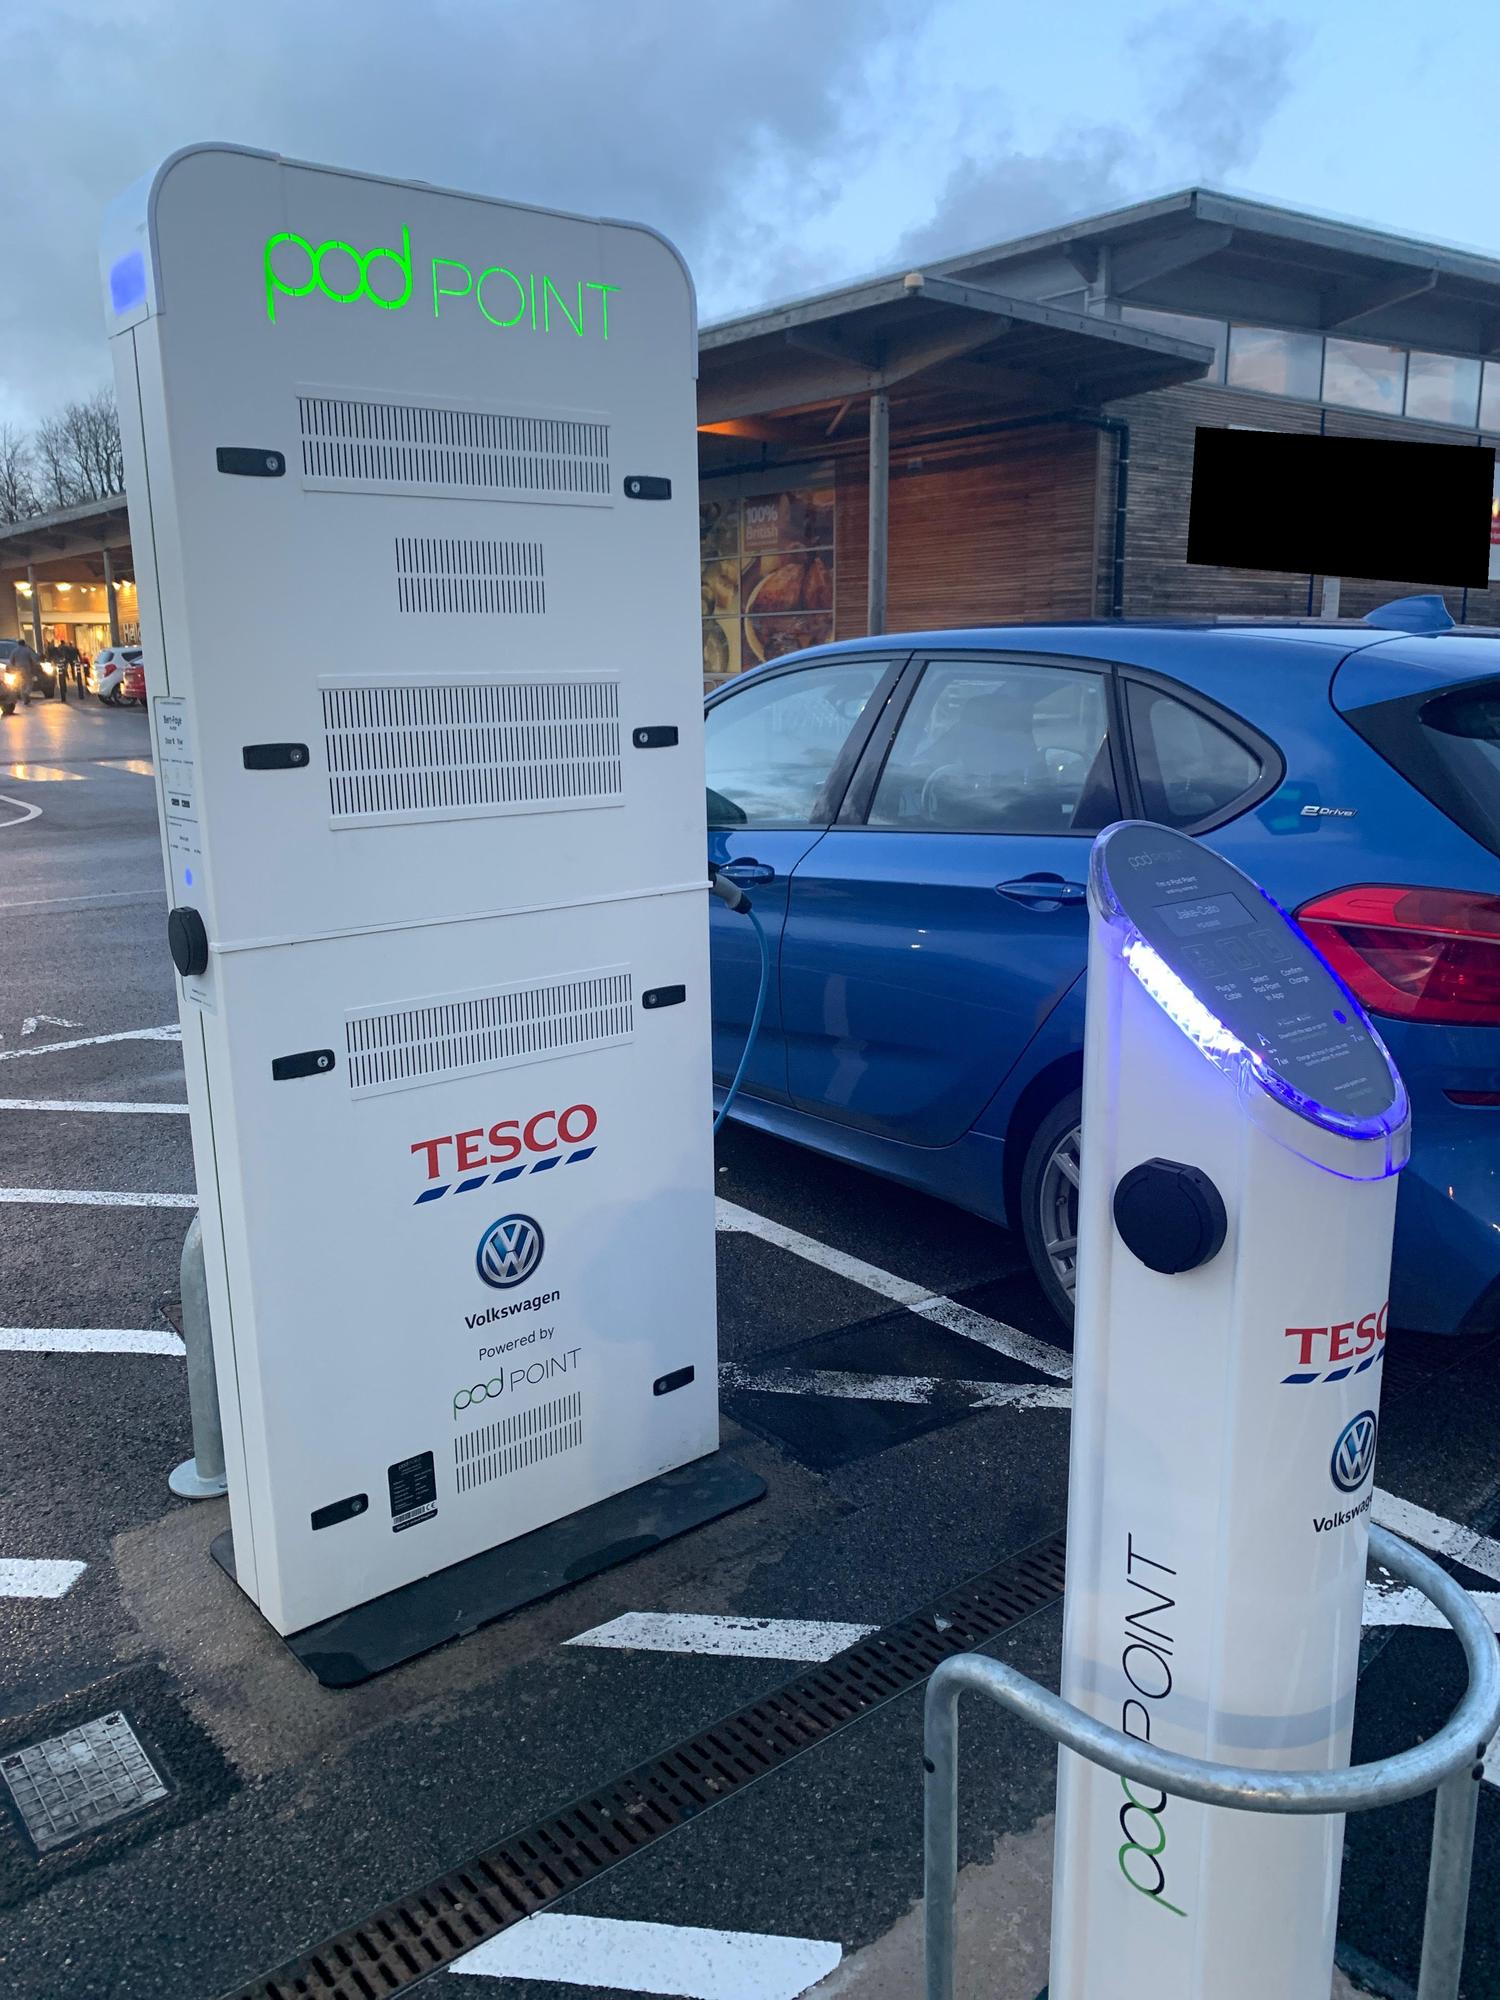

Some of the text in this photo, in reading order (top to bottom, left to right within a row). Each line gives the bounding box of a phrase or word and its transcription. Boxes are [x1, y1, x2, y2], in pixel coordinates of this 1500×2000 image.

[263, 224, 621, 340] pod POINT
[1256, 1032, 1272, 1047] A
[411, 1104, 598, 1180] TESCO
[464, 1289, 561, 1330] Volkswagen
[478, 1326, 555, 1361] Powered by
[453, 1348, 582, 1420] pod POINT
[1312, 1495, 1374, 1533] Volkswag
[1122, 1531, 1177, 1744] POINT
